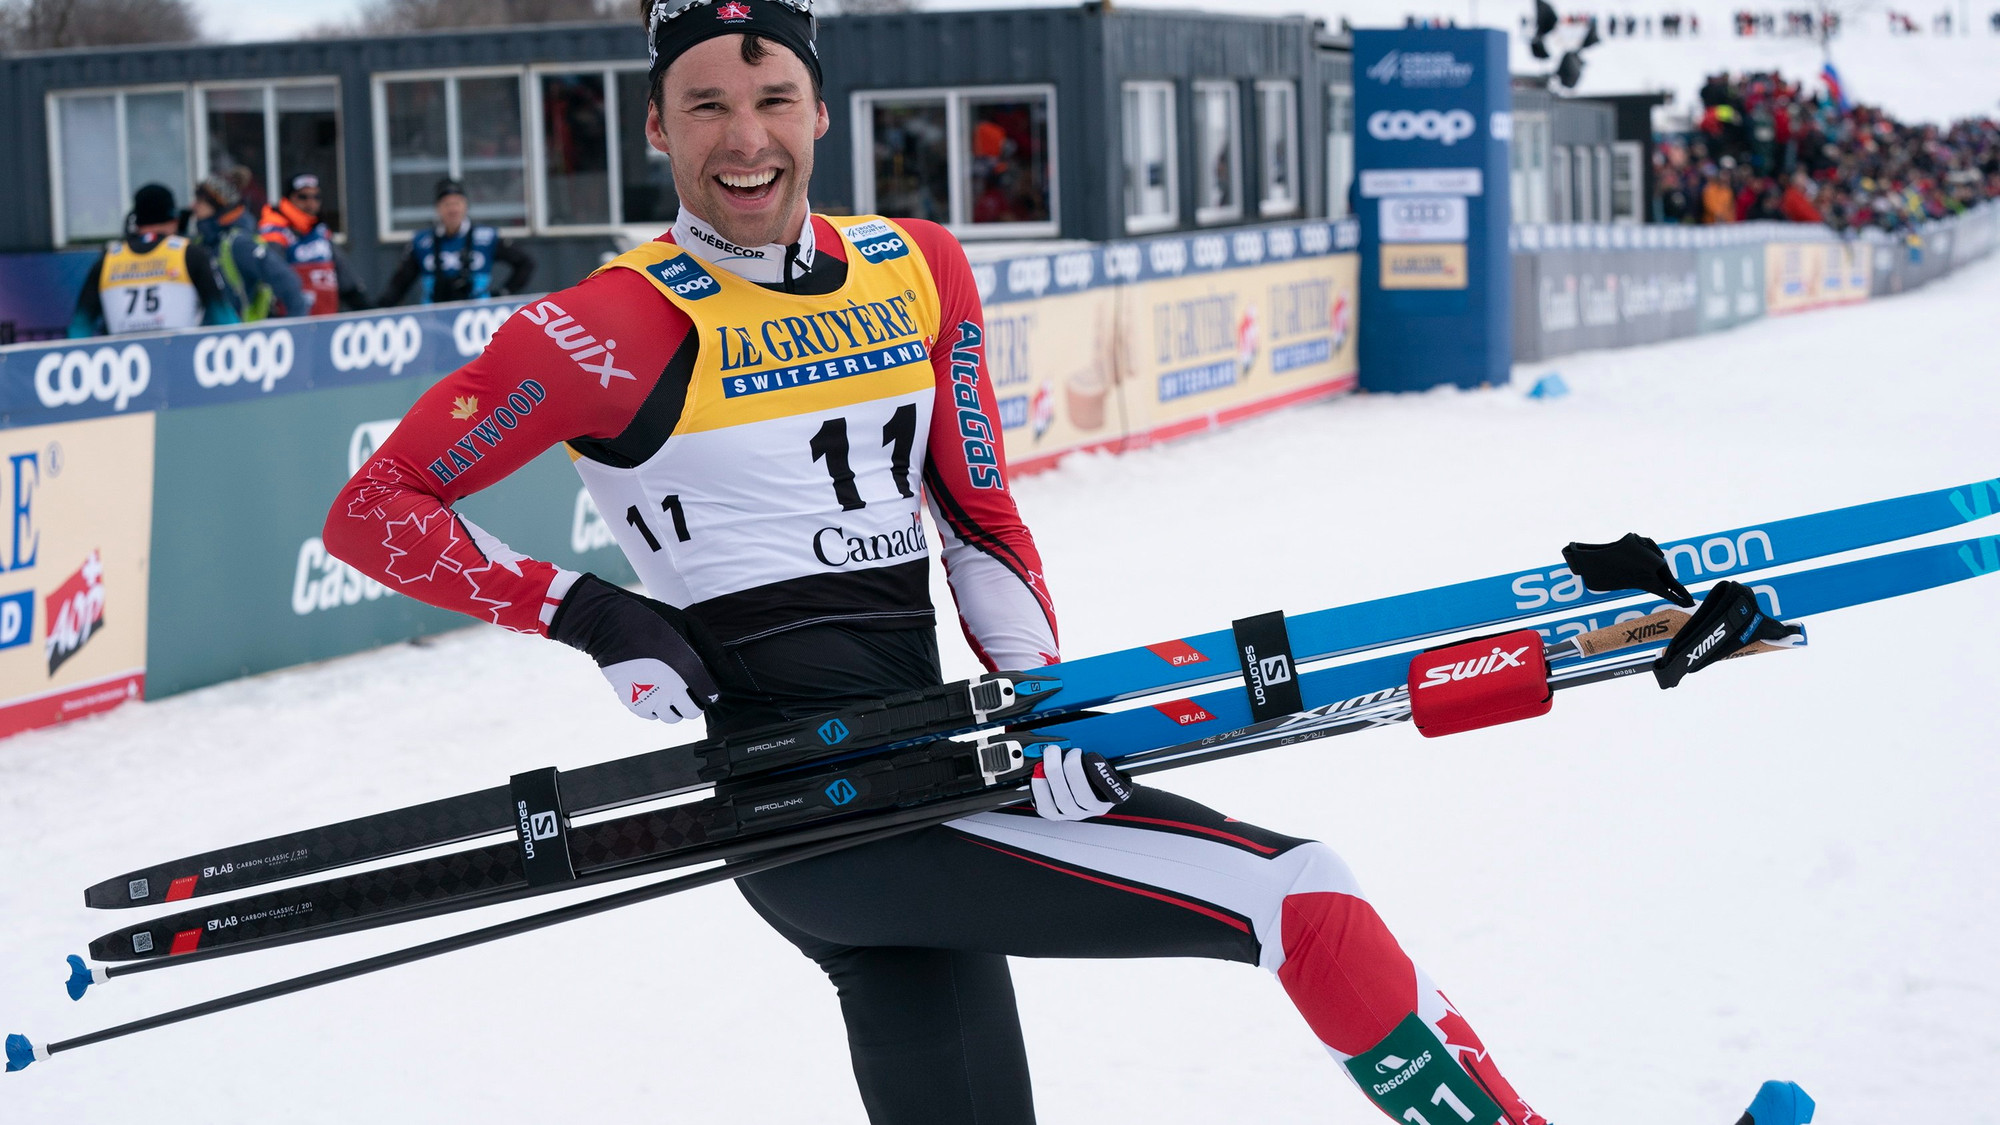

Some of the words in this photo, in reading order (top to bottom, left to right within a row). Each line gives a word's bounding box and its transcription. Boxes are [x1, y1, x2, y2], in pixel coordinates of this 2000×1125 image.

[1366, 109, 1477, 146] coop
[690, 226, 765, 259] QUÉBECOR
[860, 238, 903, 256] coop
[125, 286, 160, 315] 75
[193, 328, 295, 392] coop
[330, 315, 423, 376] coop
[716, 326, 763, 372] LE
[733, 344, 924, 394] SWITZERLAND
[34, 343, 151, 411] coop
[427, 378, 546, 486] HAYWOOD
[809, 402, 917, 512] 11
[626, 494, 692, 553] 11
[813, 512, 927, 567] Canada
[1245, 645, 1266, 706] salomon
[517, 800, 536, 859] salomon
[236, 858, 263, 870] CARBON
[264, 852, 290, 863] CLASSIC
[297, 848, 308, 857] 201
[240, 911, 268, 922] CARBON
[269, 905, 295, 916] CLASSIC
[301, 901, 313, 910] 201
[1373, 1049, 1432, 1096] Cascades
